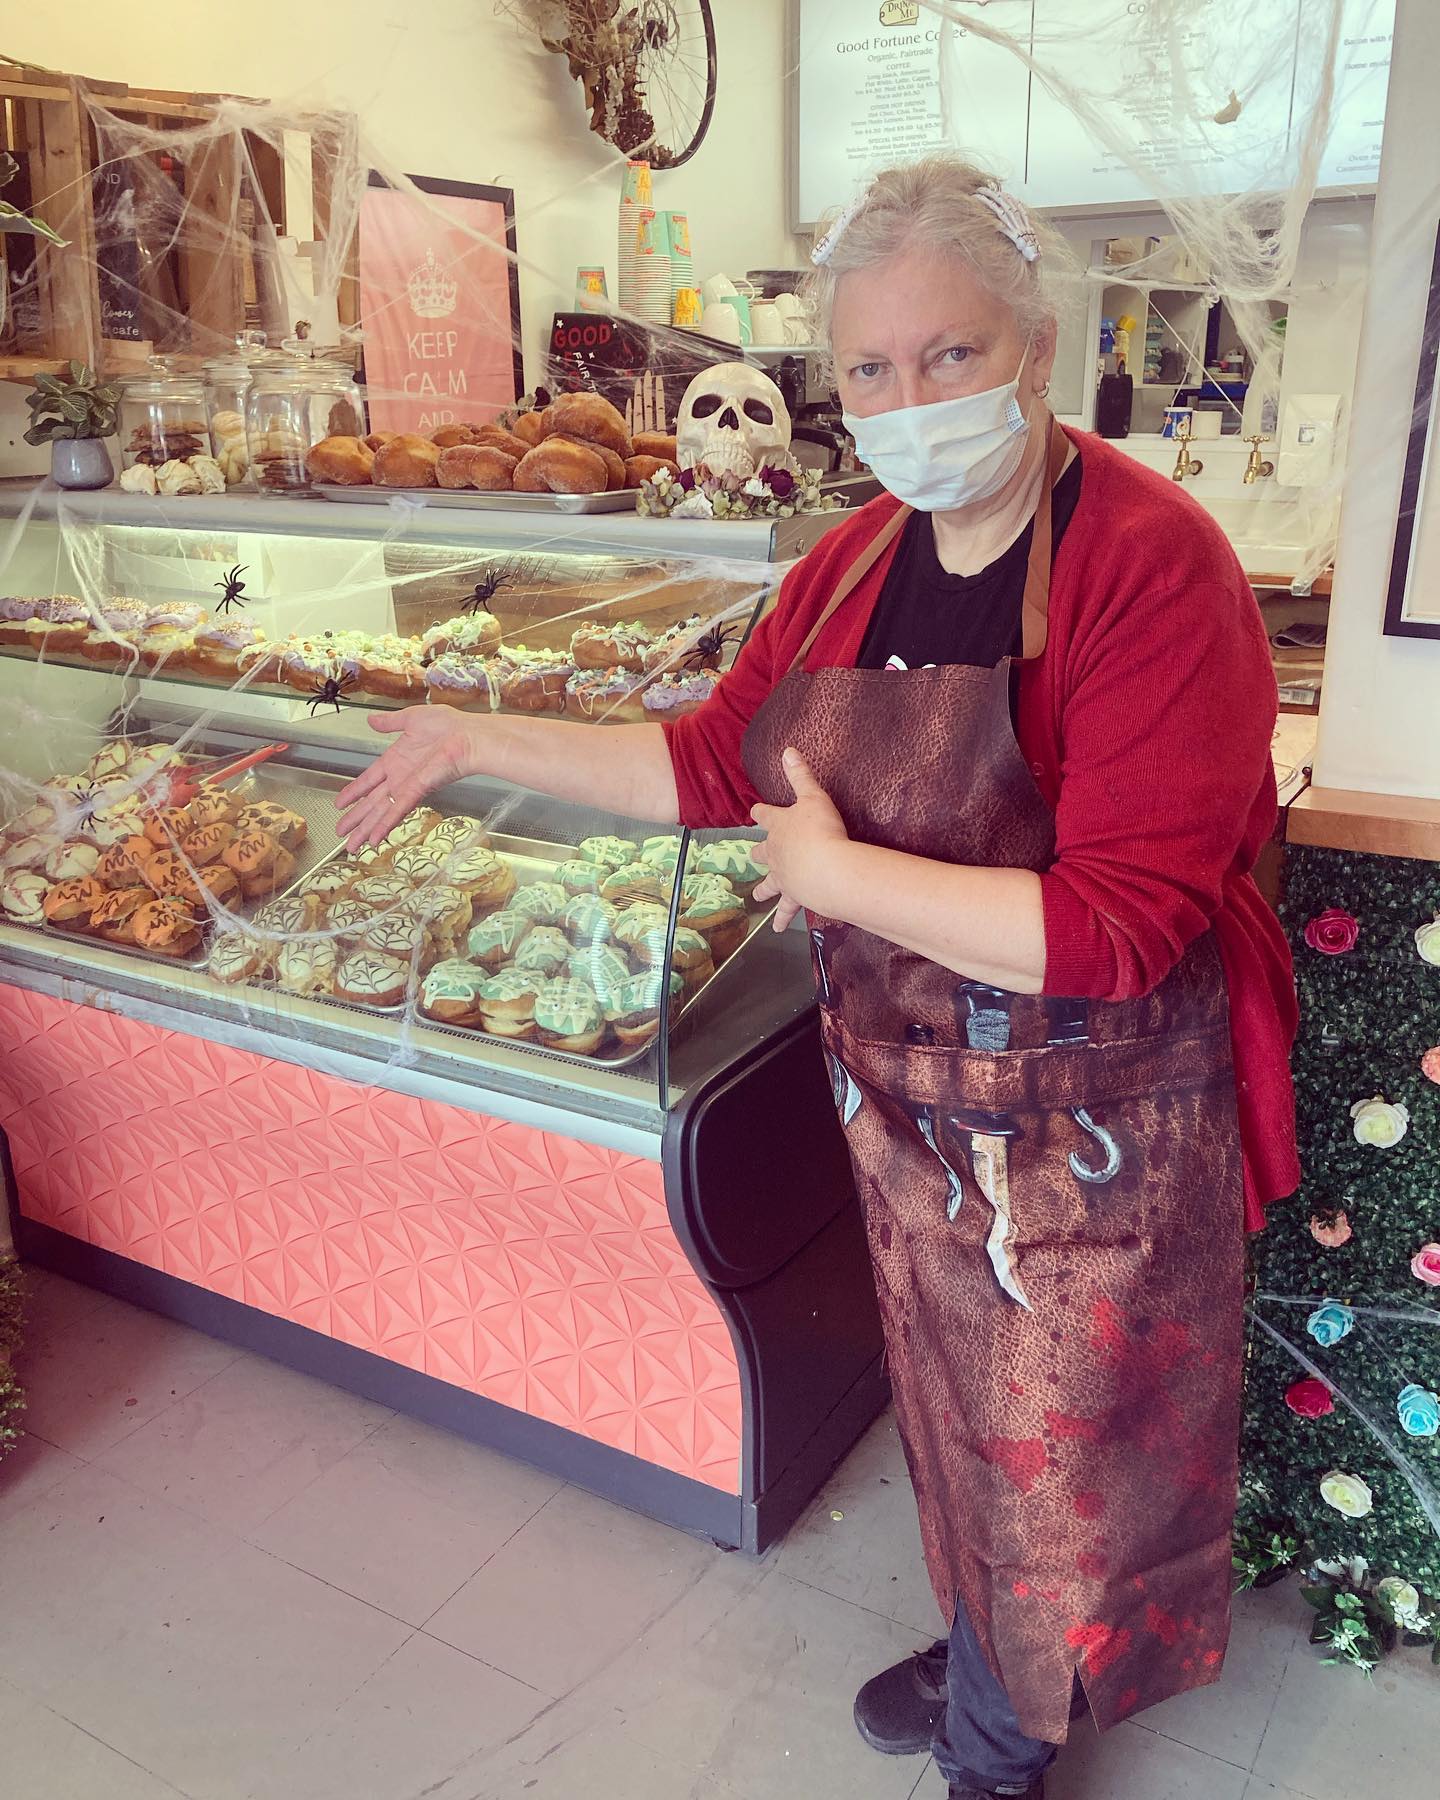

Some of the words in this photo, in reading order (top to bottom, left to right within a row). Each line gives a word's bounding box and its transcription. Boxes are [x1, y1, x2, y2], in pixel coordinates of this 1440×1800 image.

[836, 40, 869, 53] Good
[873, 34, 921, 49] Fortune
[925, 28, 967, 42] Coee
[900, 47, 934, 58] Fairtrade
[112, 326, 140, 337] cafe
[406, 330, 458, 359] KEEP
[554, 322, 611, 349] GOOD
[403, 369, 468, 397] CALM
